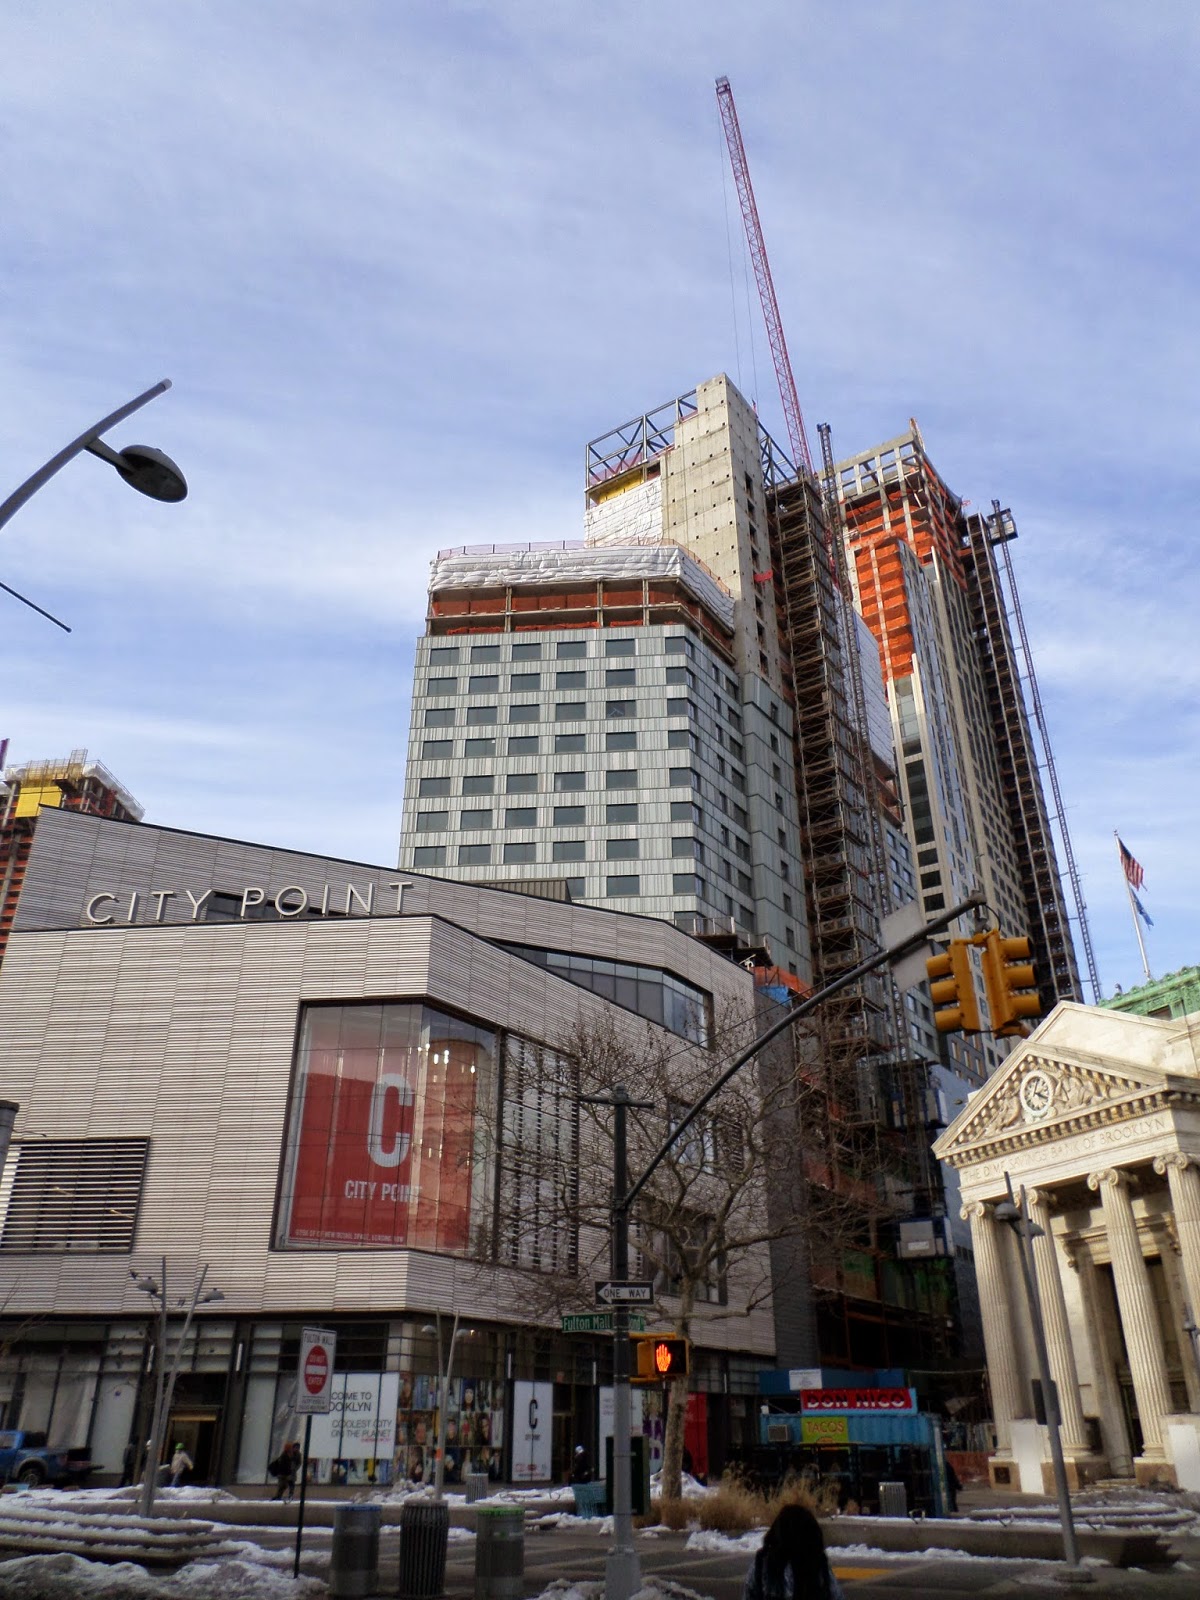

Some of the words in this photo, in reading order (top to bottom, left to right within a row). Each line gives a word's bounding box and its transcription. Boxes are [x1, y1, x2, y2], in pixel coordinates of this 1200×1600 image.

[87, 889, 214, 923] CITY
[240, 882, 413, 918] POINT
[368, 1073, 413, 1168] C
[963, 1167, 982, 1182] THE
[1051, 1140, 1083, 1158] BANK
[1084, 1135, 1097, 1149] OF
[1100, 1117, 1166, 1143] BROOKLYN
[344, 1180, 377, 1200] CITY
[381, 1183, 422, 1204] POINT
[604, 1288, 621, 1298] ONE
[628, 1288, 647, 1298] WAY
[563, 1316, 590, 1331] Fulton
[593, 1314, 611, 1329] Mall
[304, 1333, 321, 1343] FULTON
[331, 1391, 358, 1400] COME
[361, 1391, 372, 1400] TO
[807, 1392, 849, 1408] DON
[856, 1391, 905, 1408] NICO
[329, 1401, 372, 1412] OOKLYN
[332, 1419, 370, 1429] COOLEST
[373, 1419, 392, 1428] CITY
[806, 1420, 844, 1433] TACOS
[347, 1430, 360, 1438] THE
[361, 1429, 391, 1438] PLANET
